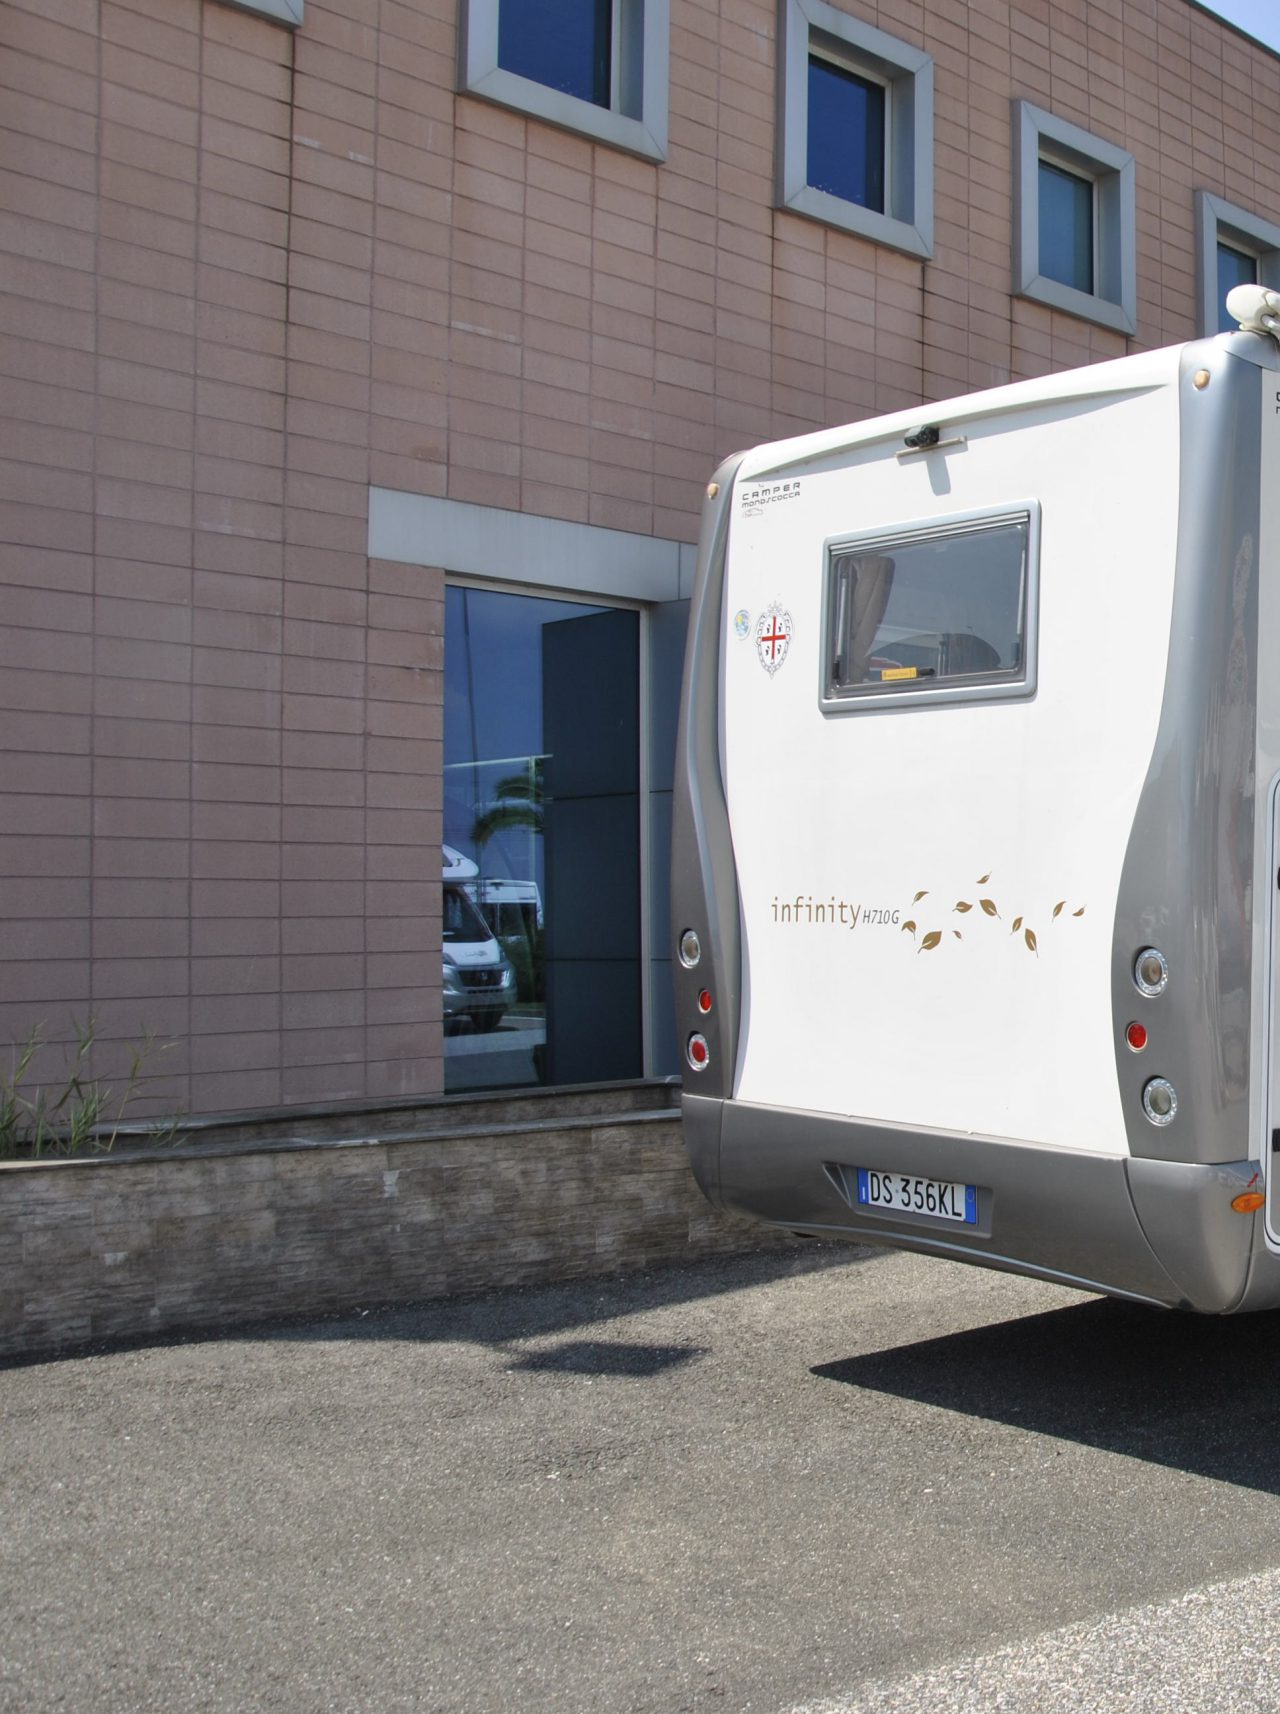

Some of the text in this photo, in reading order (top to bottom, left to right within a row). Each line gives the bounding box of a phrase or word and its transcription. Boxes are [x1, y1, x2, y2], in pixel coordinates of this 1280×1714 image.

[742, 482, 801, 501] CAMPER
[771, 896, 861, 930] infinity
[870, 1172, 893, 1204] DS
[901, 1178, 962, 1217] 356KL
